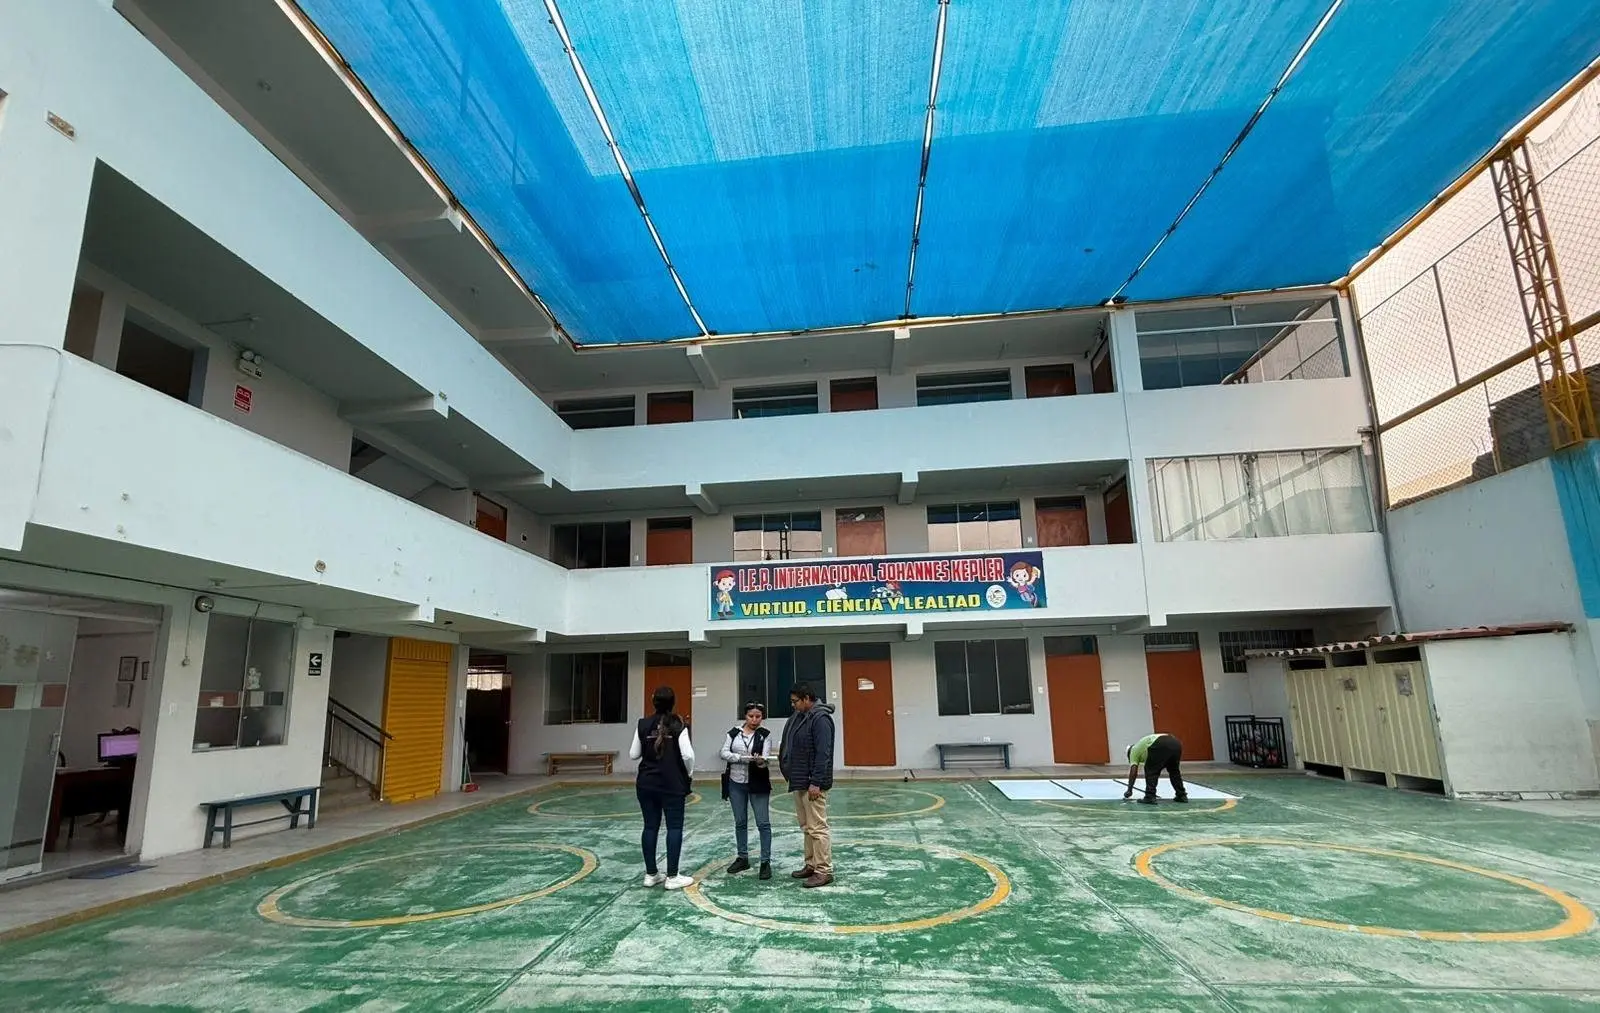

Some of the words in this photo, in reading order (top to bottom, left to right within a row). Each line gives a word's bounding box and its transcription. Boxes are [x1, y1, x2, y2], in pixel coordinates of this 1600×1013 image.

[739, 568, 773, 592] I.E.P.
[774, 562, 877, 591] INTERNACIONAL
[877, 561, 950, 582] JOHANNES
[950, 557, 1005, 582] KEPLER
[741, 600, 812, 617] VIRTUD,
[816, 597, 884, 613] CIENCIA
[887, 597, 900, 611] Y
[904, 594, 981, 611] LEALTAD
